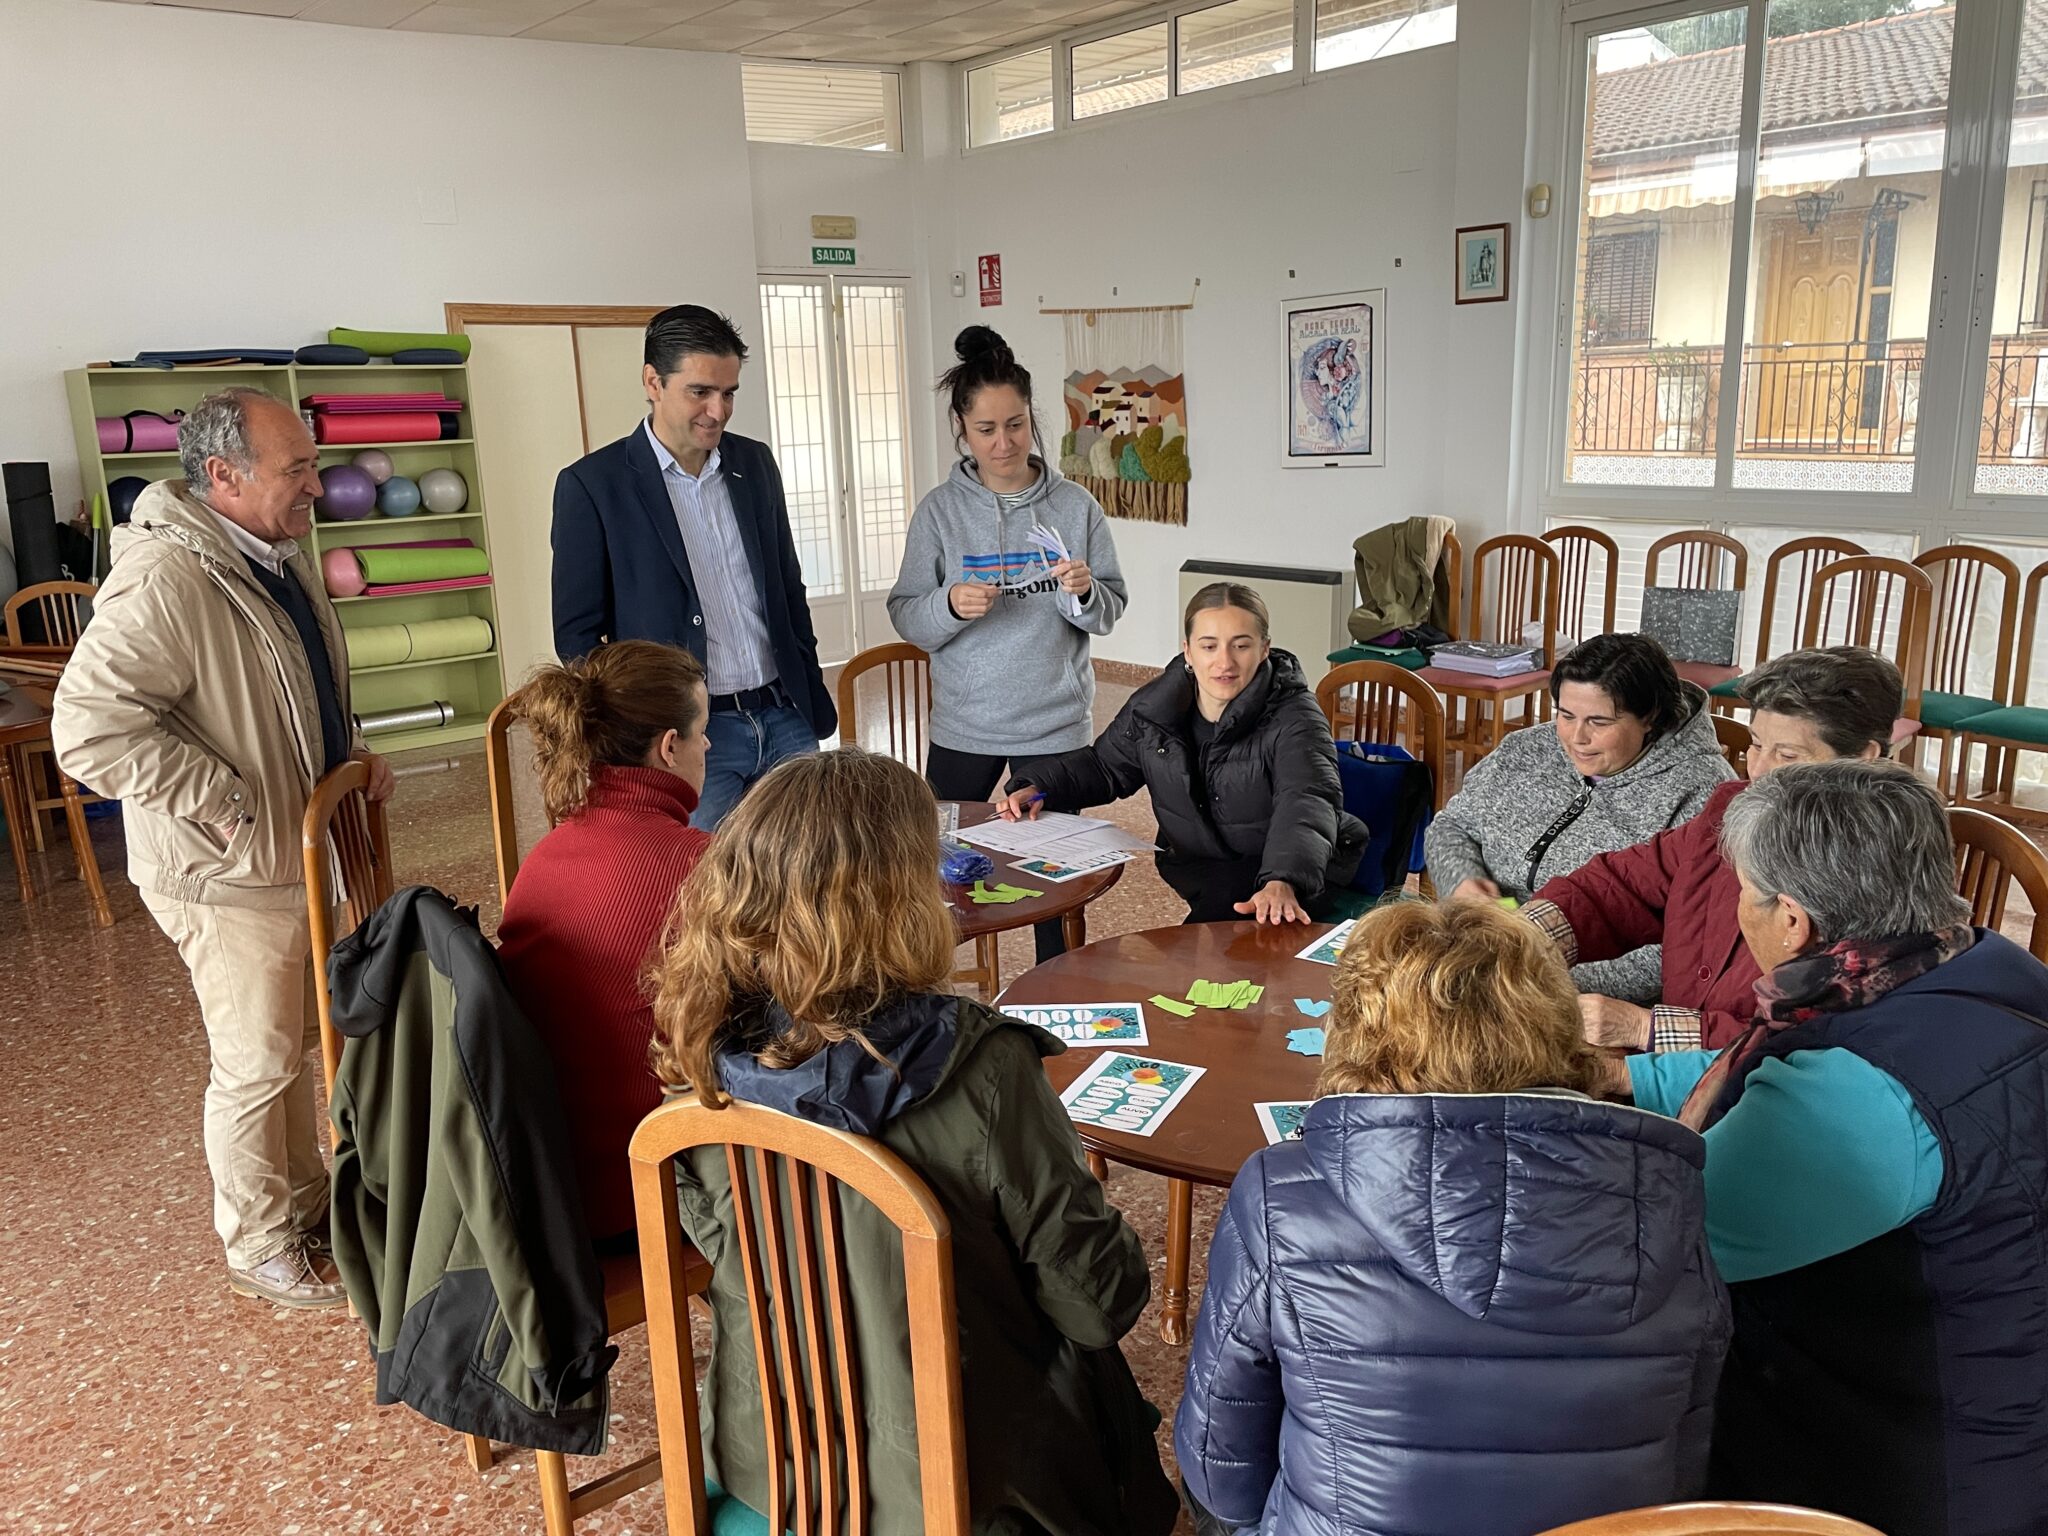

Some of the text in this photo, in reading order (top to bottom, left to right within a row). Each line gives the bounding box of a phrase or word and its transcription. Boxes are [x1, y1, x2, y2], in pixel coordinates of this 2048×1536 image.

[816, 249, 852, 262] SALIDA
[1547, 807, 1579, 836] DANCE
[1121, 1106, 1149, 1115] ALIVIO
